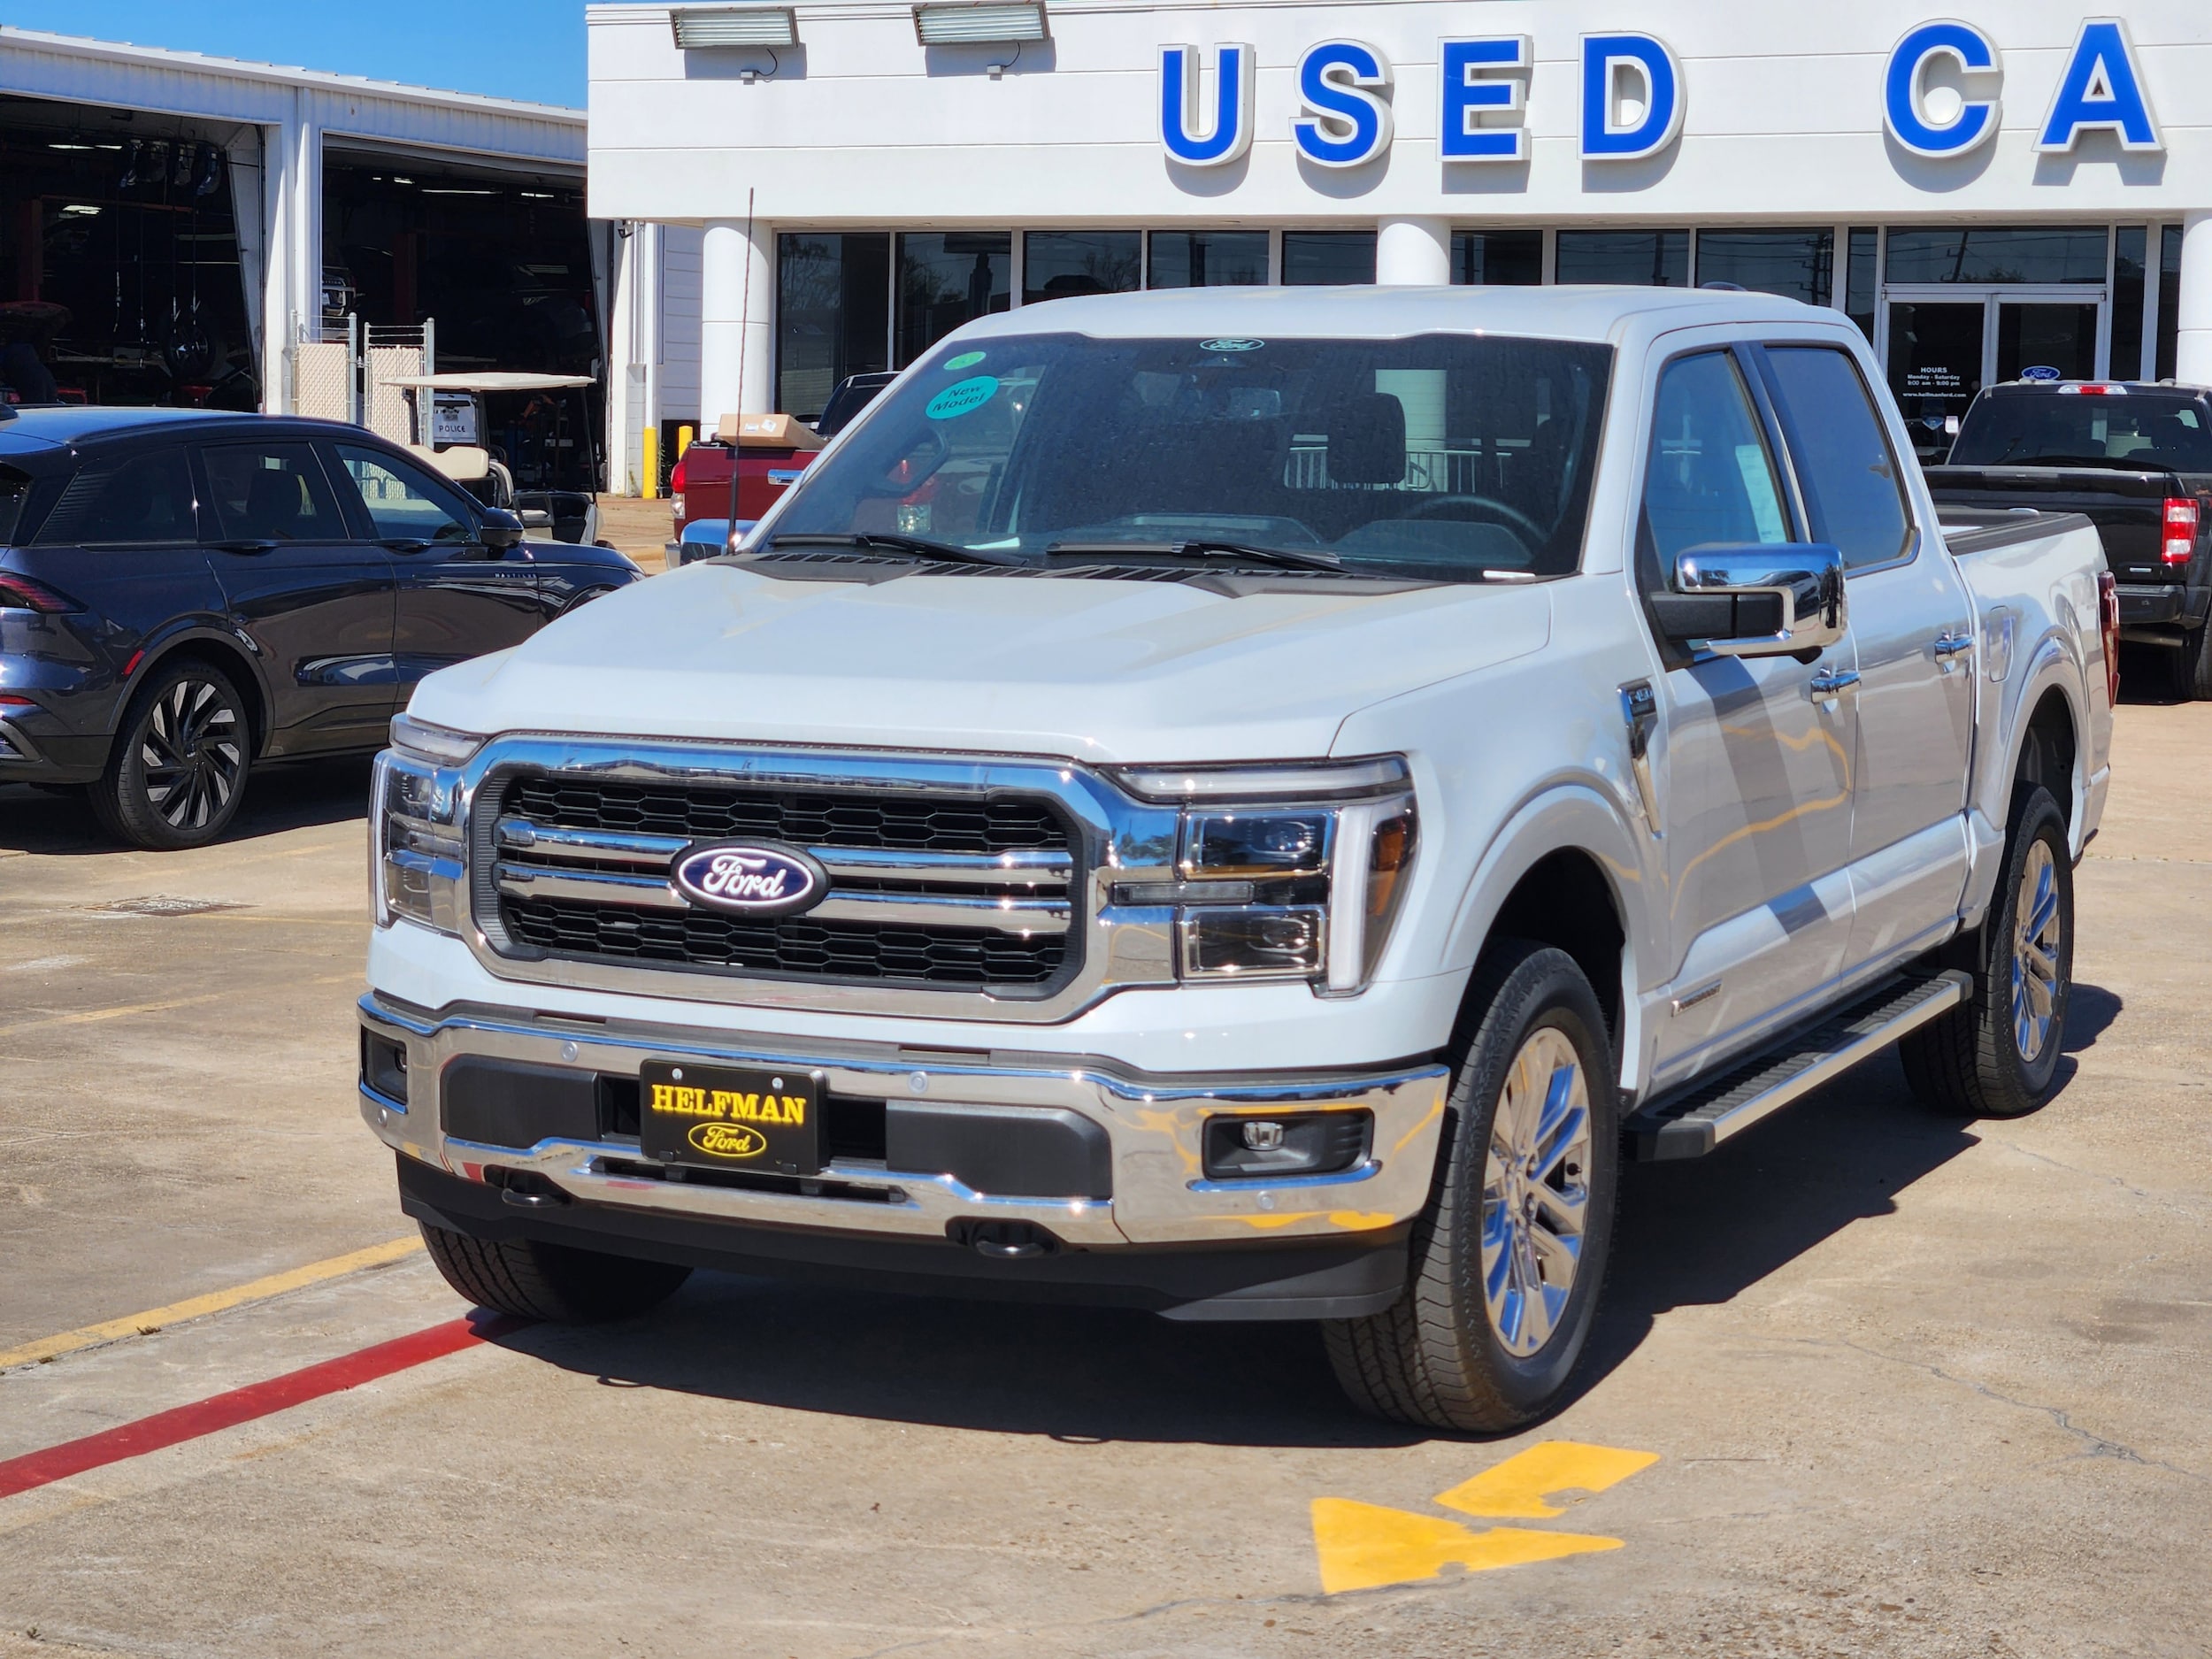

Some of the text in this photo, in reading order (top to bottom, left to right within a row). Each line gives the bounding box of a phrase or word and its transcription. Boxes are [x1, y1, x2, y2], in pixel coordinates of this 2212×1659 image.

[1156, 16, 2168, 168] USED CA
[1209, 339, 1255, 349] Ford
[2029, 367, 2053, 379] Ford
[932, 392, 986, 412] Model
[947, 385, 984, 398] New
[703, 854, 787, 898] Ford
[651, 1084, 807, 1125] HELFMAN
[702, 1125, 751, 1152] Ford
